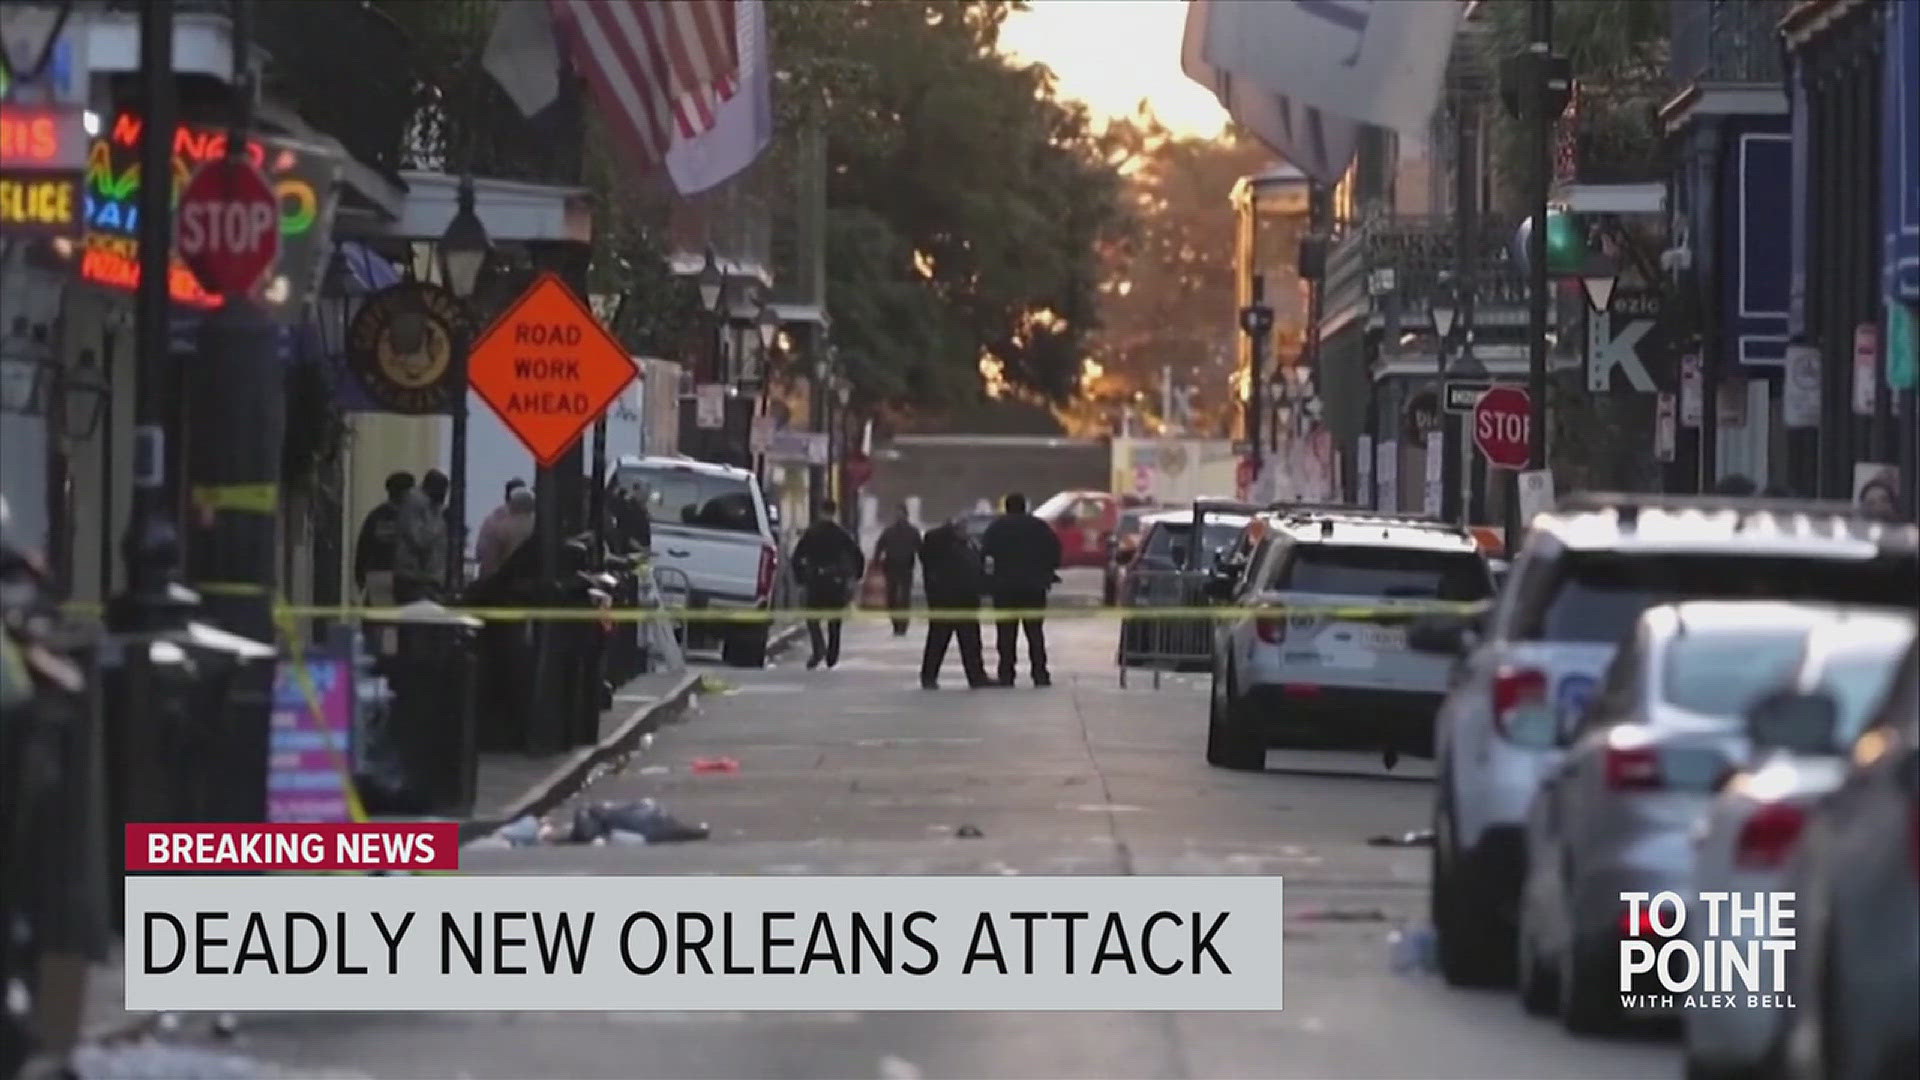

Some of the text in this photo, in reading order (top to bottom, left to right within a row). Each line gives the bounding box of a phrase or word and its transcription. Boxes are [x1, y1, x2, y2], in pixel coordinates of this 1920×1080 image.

[181, 203, 273, 251] STOP
[515, 324, 581, 347] ROAD
[514, 358, 580, 381] WORK
[507, 393, 589, 415] AHEAD
